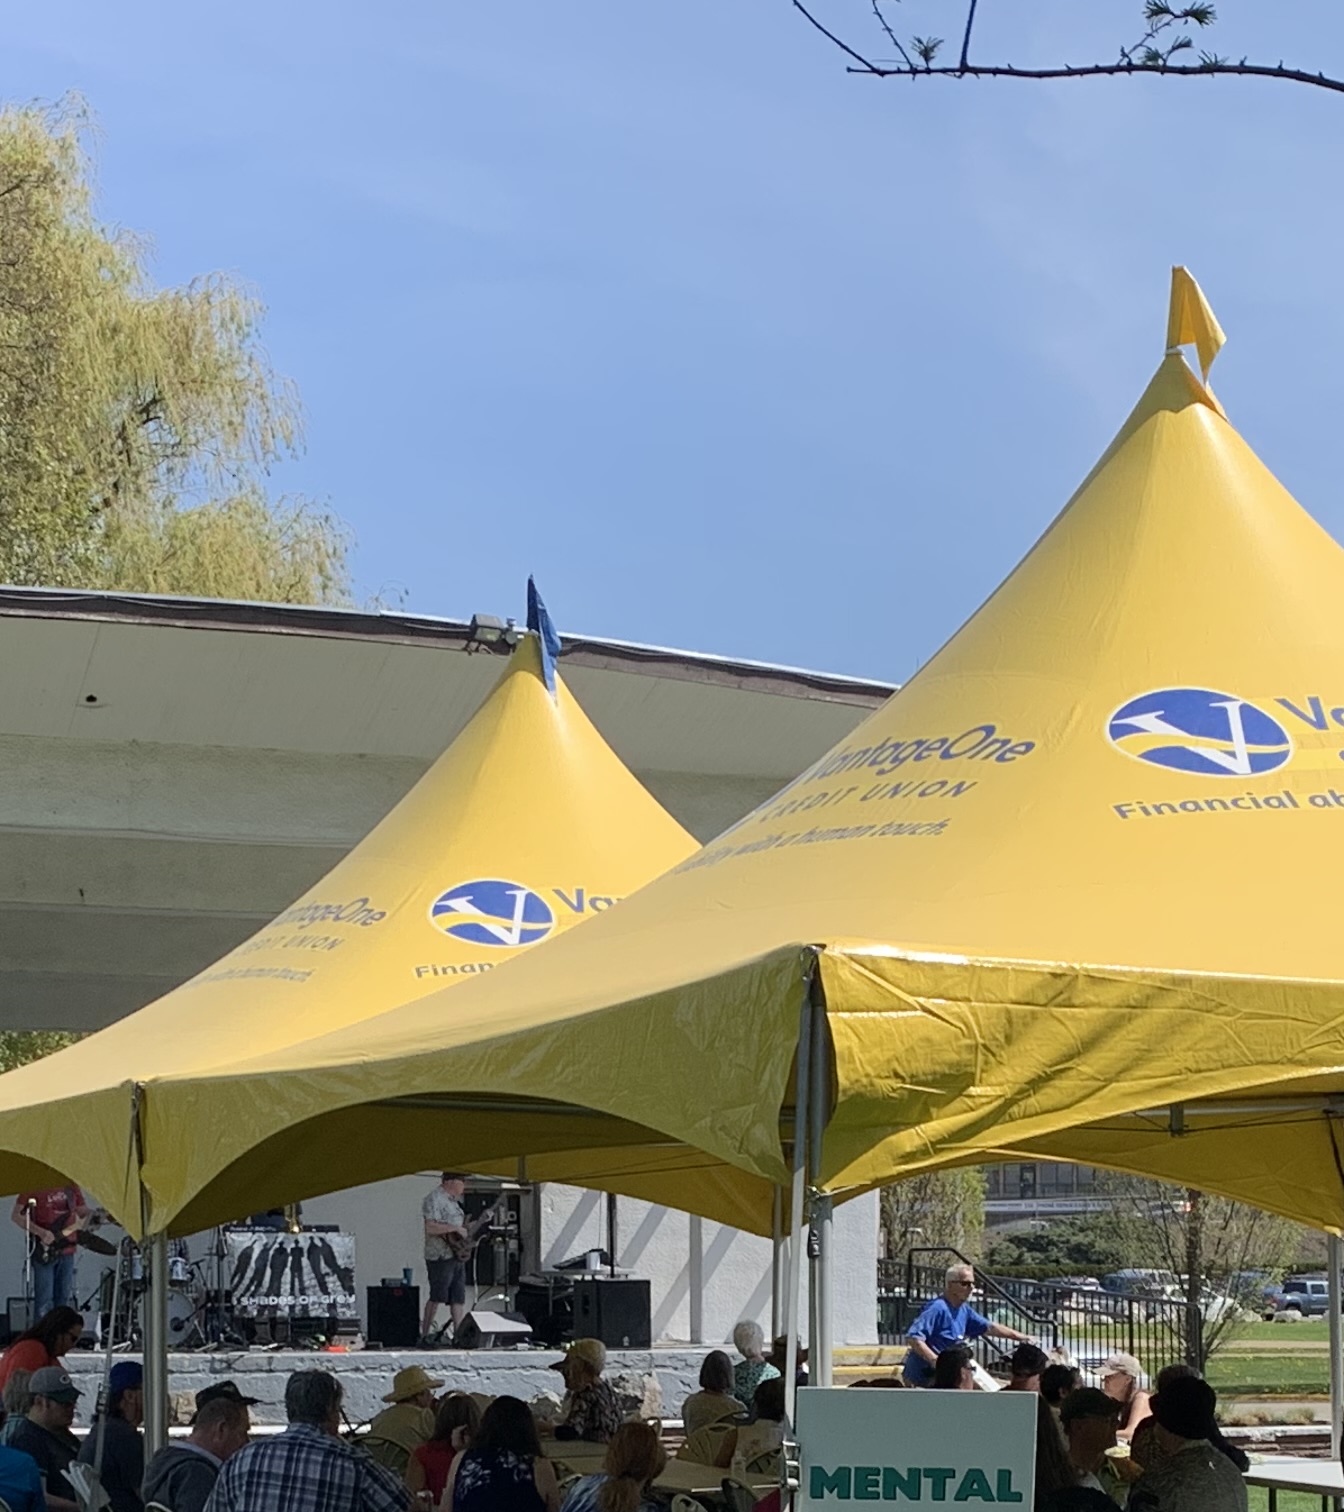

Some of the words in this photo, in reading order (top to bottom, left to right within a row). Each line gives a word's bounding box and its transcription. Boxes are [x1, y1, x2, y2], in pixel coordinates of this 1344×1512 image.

[859, 779, 978, 802] UNION
[1112, 790, 1300, 820] Financial
[552, 888, 626, 914] Va
[809, 1466, 1023, 1503] MENTAL
